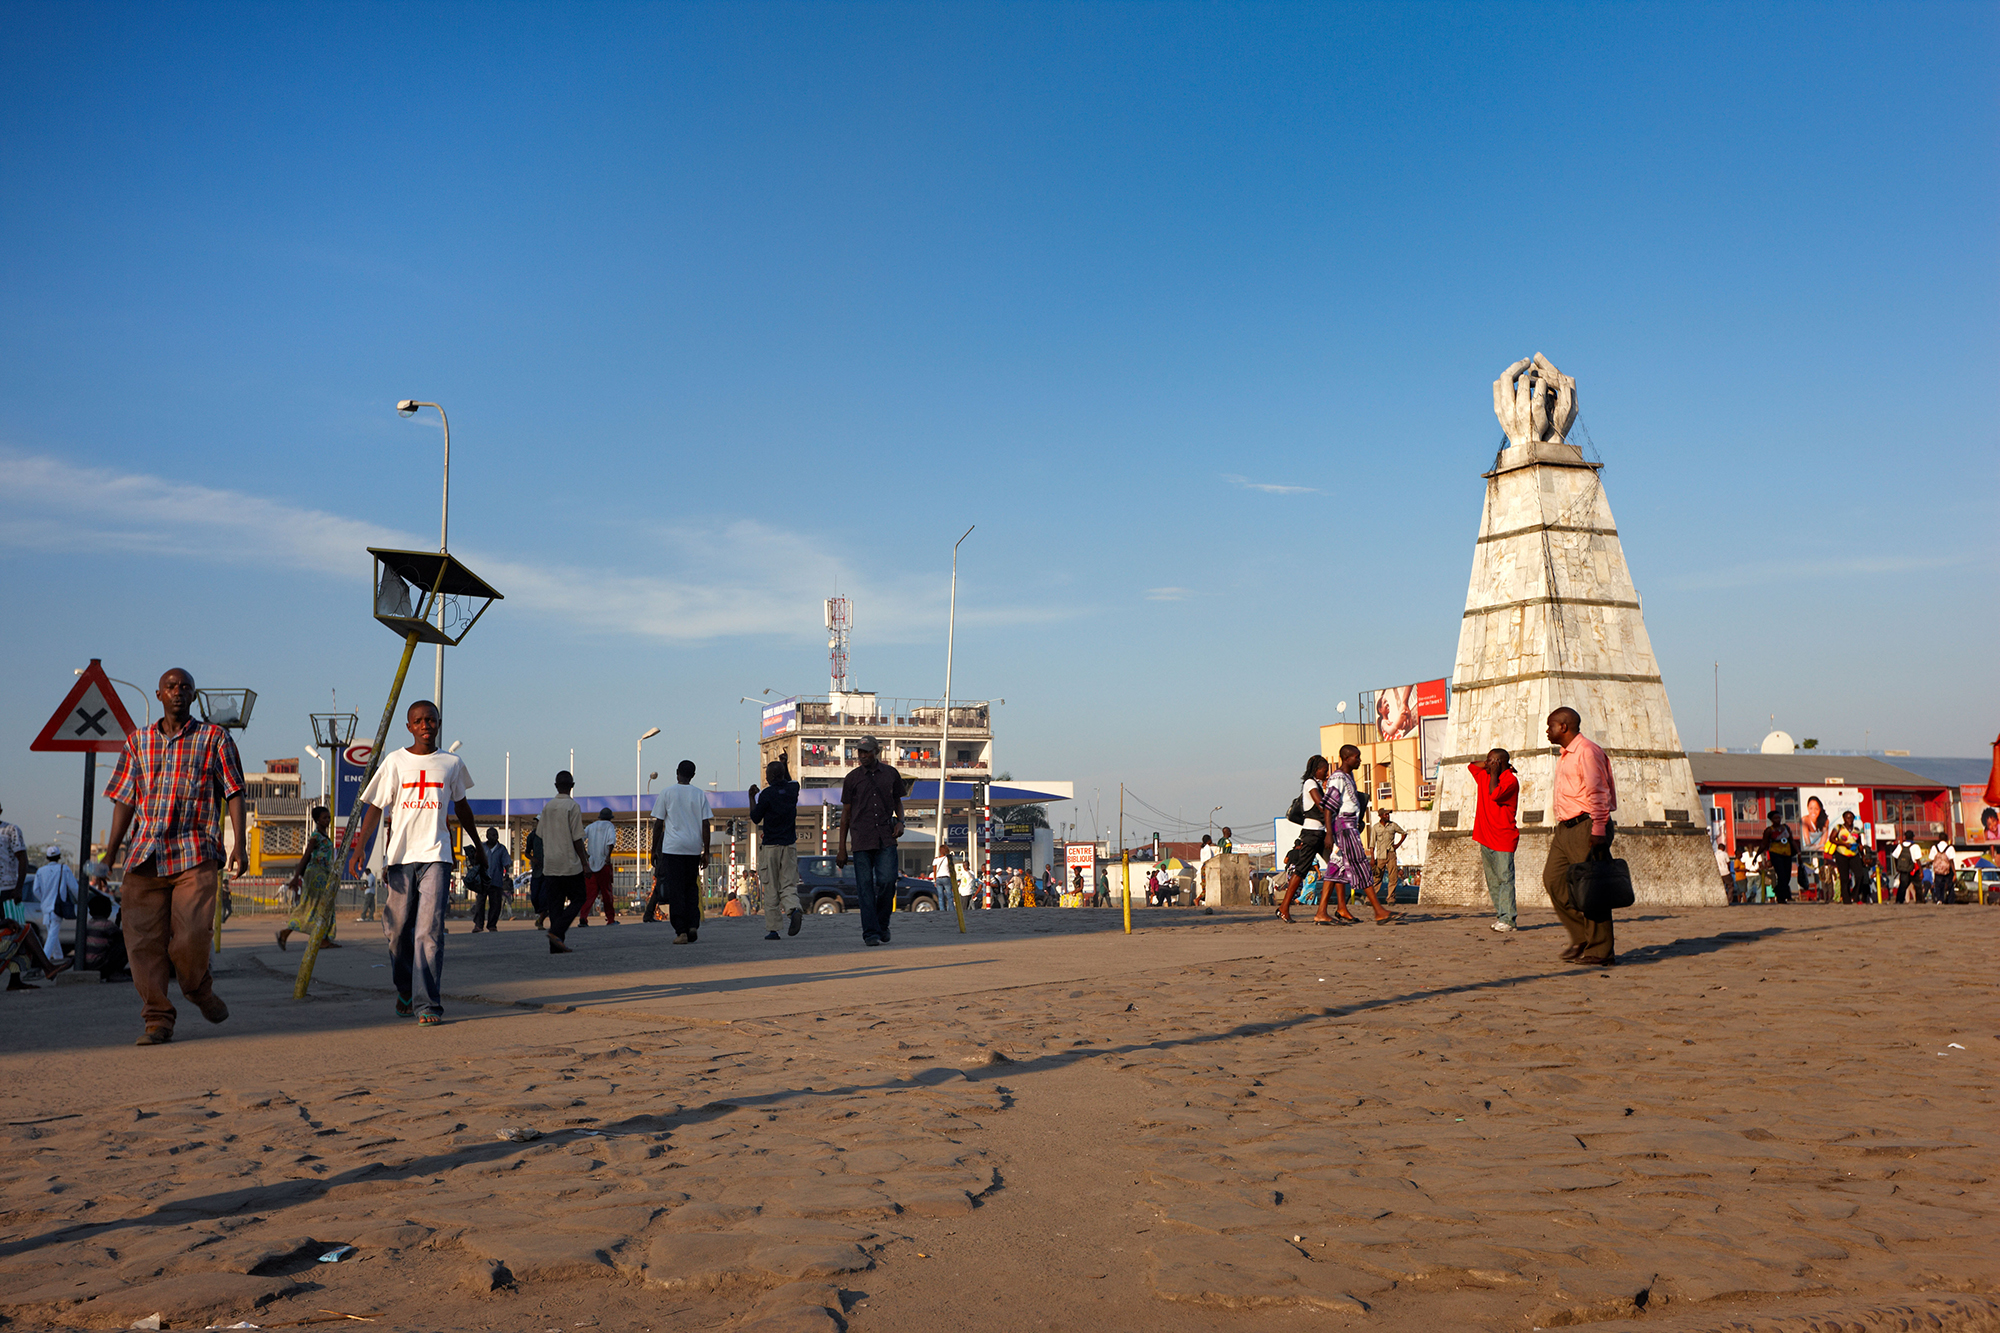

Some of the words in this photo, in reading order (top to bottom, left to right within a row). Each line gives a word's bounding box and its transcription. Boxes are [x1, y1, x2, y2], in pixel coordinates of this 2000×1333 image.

[401, 801, 442, 809] NGLAND
[949, 826, 995, 836] ECOAK
[1068, 847, 1092, 855] CENTRE
[1067, 855, 1093, 863] BIBLIQUE
